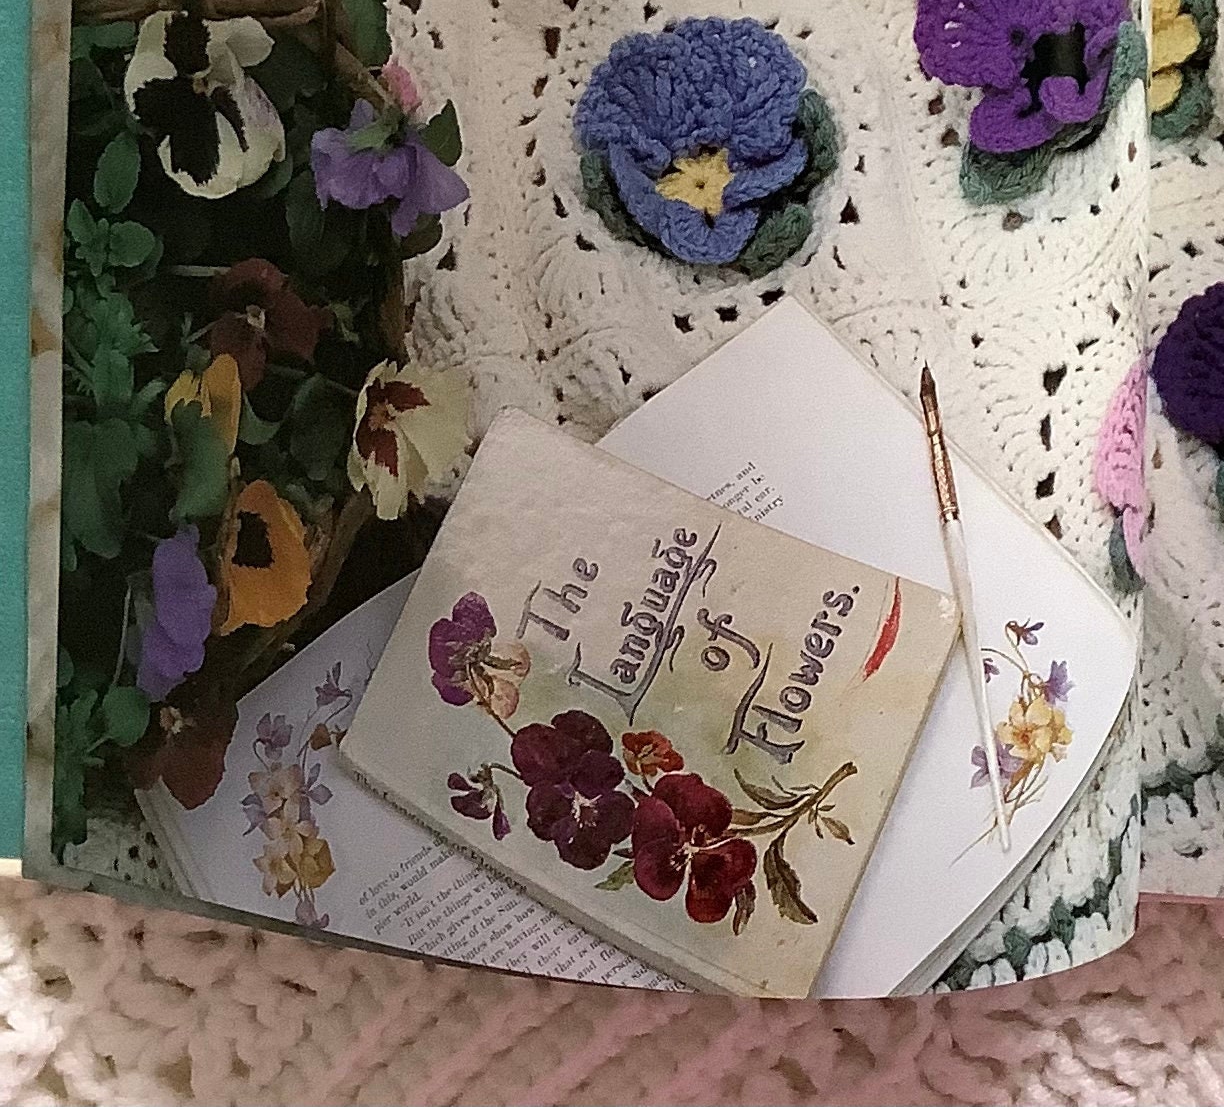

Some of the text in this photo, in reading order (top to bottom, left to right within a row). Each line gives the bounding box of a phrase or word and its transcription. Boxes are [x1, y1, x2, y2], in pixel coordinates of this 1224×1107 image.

[736, 462, 756, 480] and
[516, 557, 599, 641] The
[568, 524, 716, 726] Language
[697, 608, 761, 672] of
[722, 585, 861, 764] Flowers.
